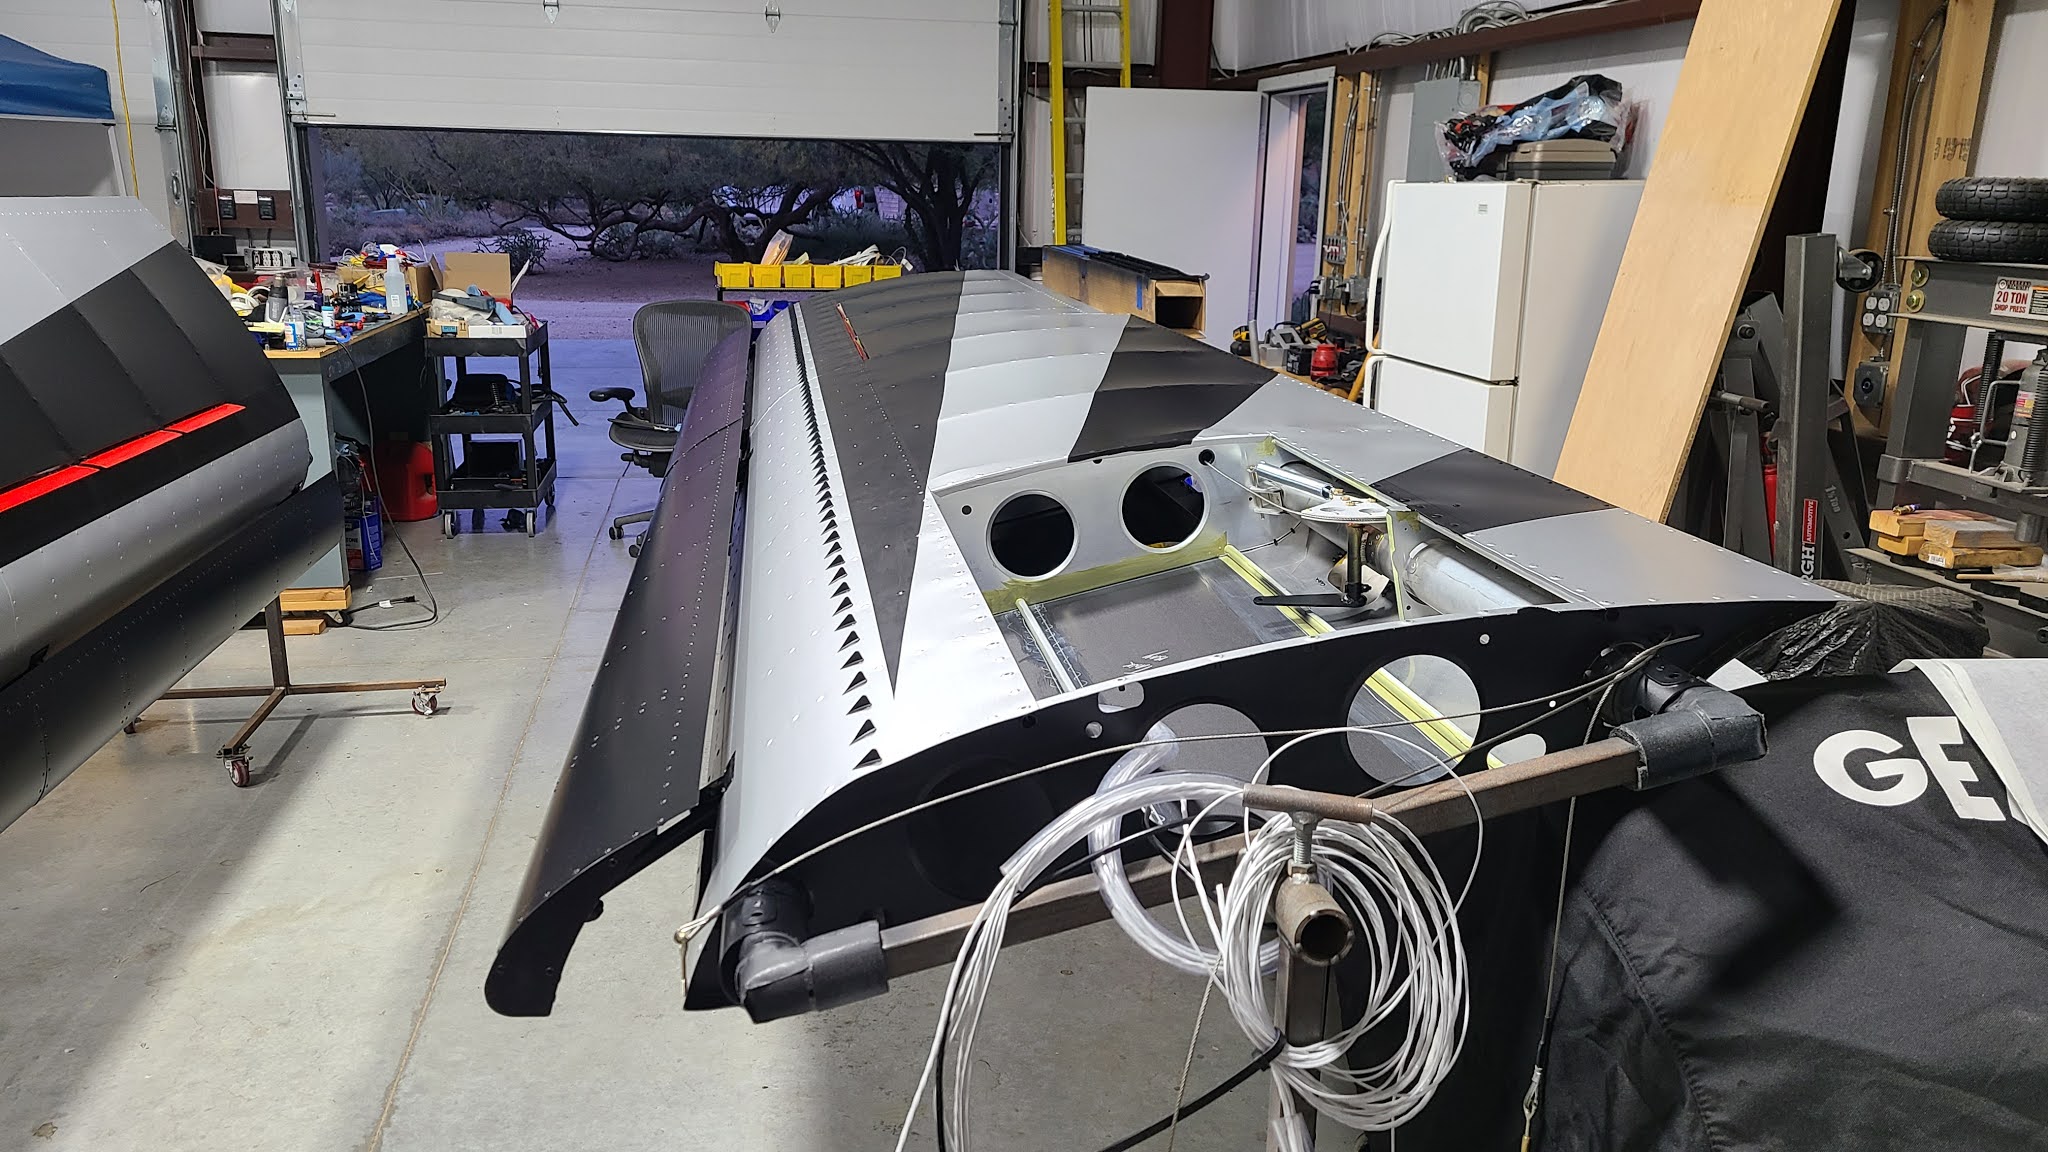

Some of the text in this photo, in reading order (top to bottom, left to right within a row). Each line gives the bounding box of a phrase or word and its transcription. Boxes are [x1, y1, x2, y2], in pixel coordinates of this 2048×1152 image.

[1996, 291, 2009, 303] 20
[2011, 292, 2029, 305] TON
[2010, 305, 2027, 313] PRESS
[1806, 500, 1814, 542] AUTOMOTIVE
[1813, 716, 2030, 827] GE
